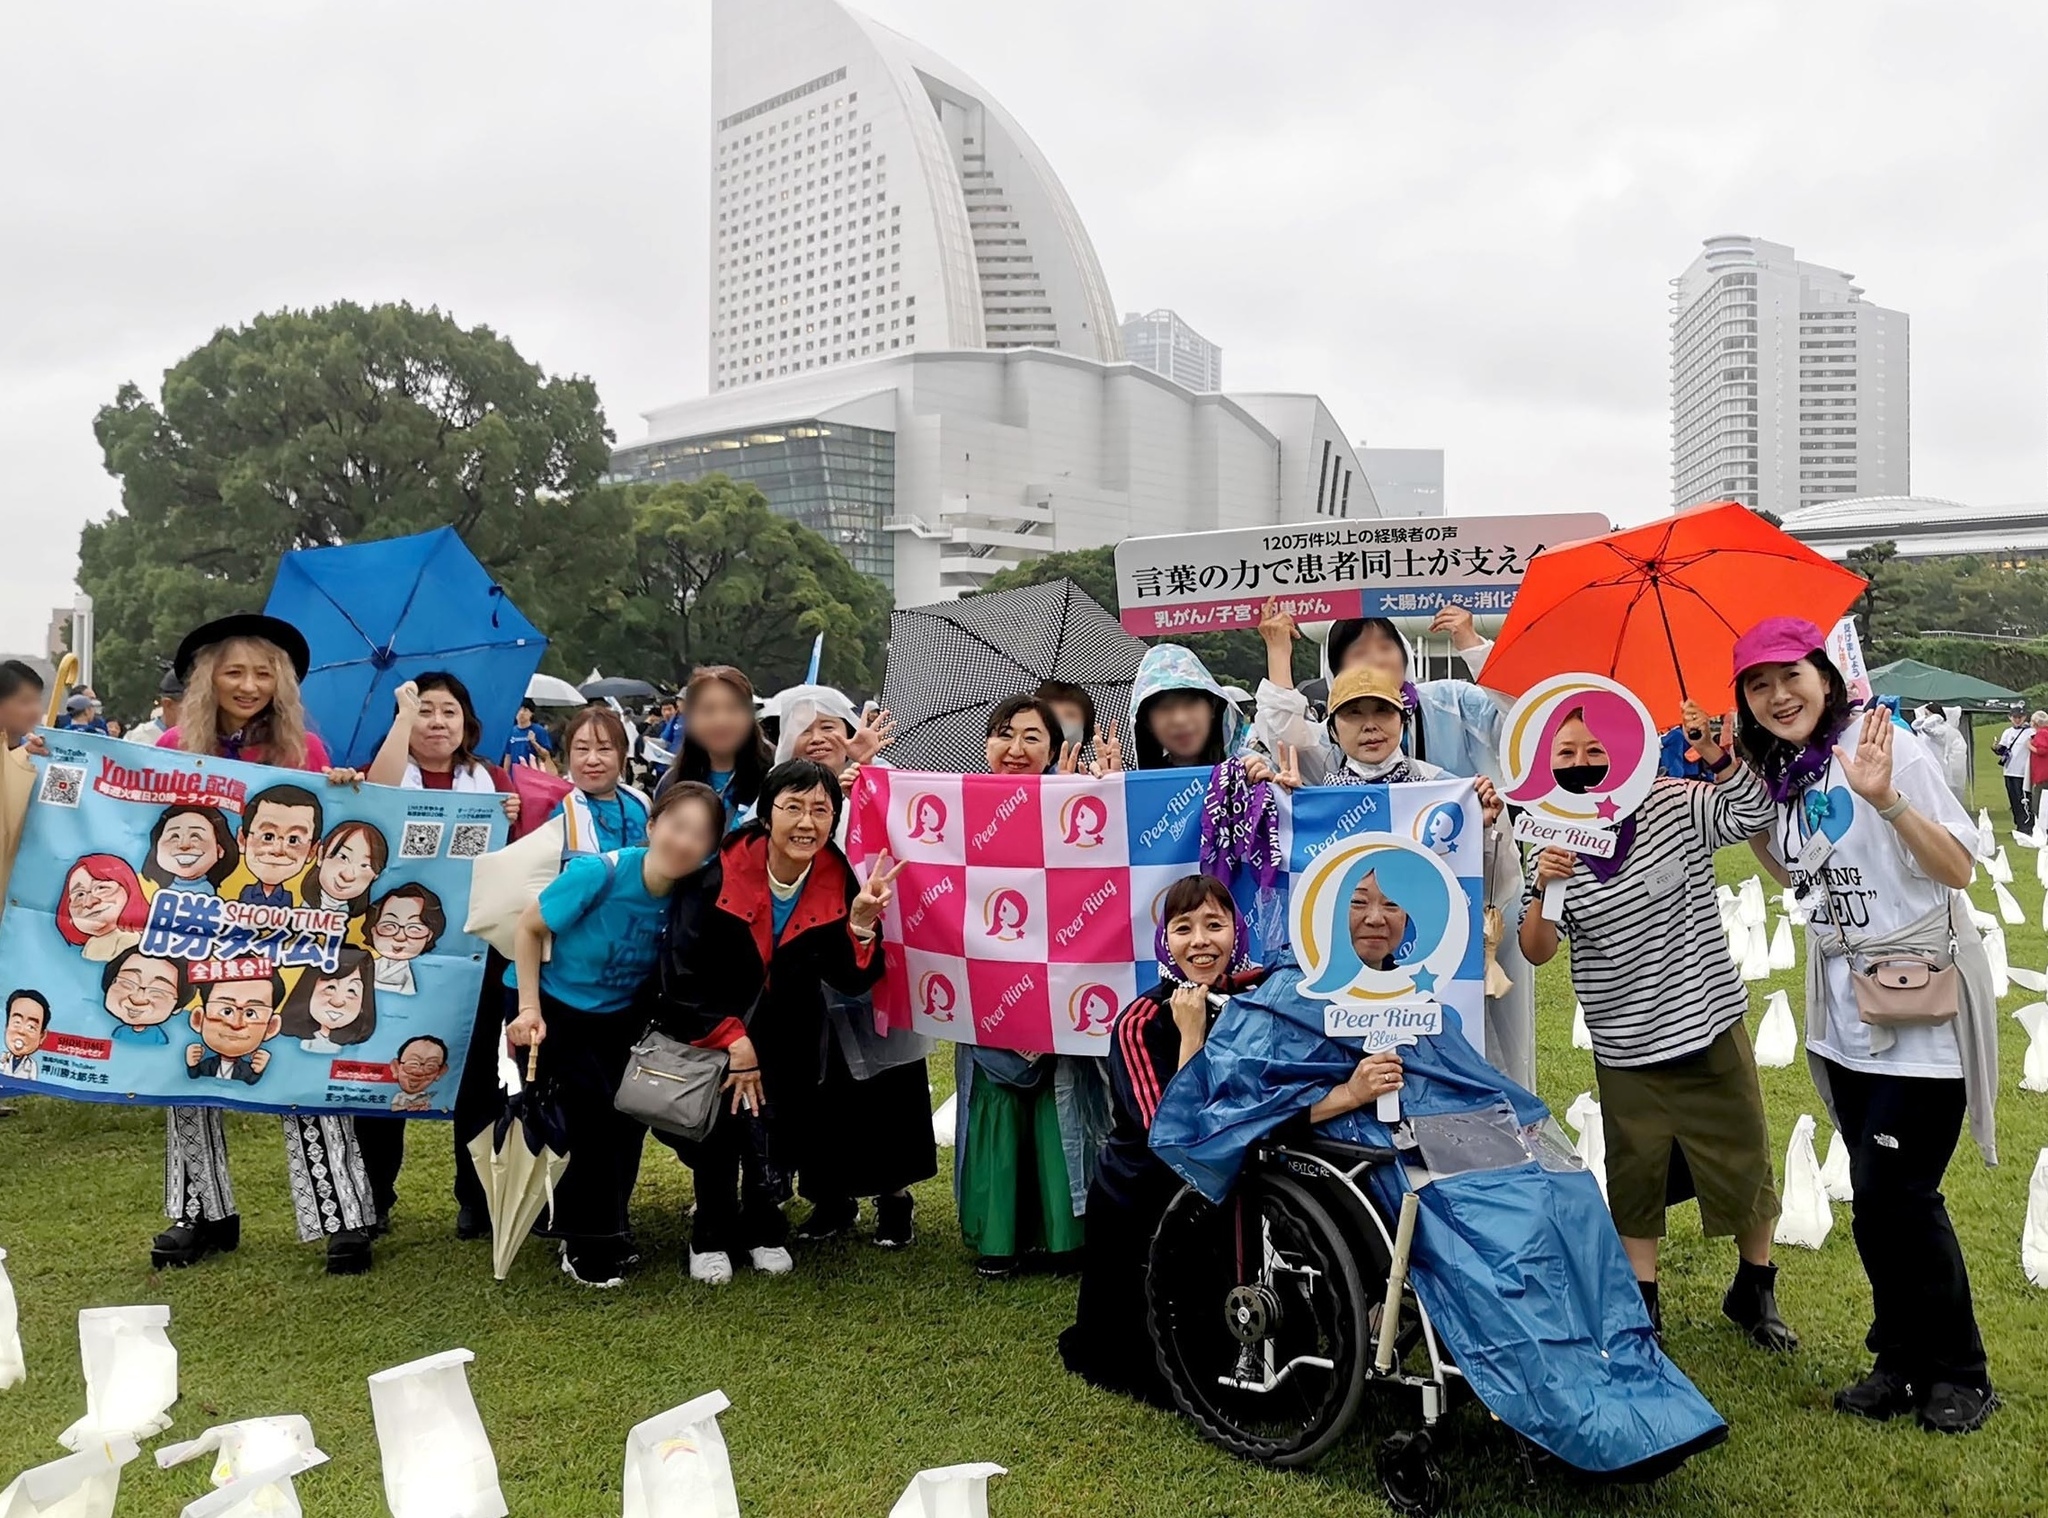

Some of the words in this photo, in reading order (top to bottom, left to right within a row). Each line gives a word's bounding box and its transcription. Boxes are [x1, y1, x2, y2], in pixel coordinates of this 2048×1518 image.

[1263, 526, 1458, 551] 120万件以上の経験者の声
[102, 755, 202, 791] YouTube
[205, 775, 247, 799] 配信
[971, 819, 999, 851] Peer
[996, 786, 1029, 822] Ring
[1139, 813, 1169, 849] Peer
[1167, 777, 1204, 816] Ring
[1303, 829, 1339, 858] Peer
[1337, 793, 1378, 834] Ring
[1268, 826, 1282, 867] JAPAN
[1519, 818, 1562, 840] Peer
[1564, 826, 1612, 855] Ring
[225, 904, 290, 928] SHOW
[294, 911, 345, 931] TIME
[904, 904, 929, 933] Peer
[919, 875, 955, 915] Ring
[1055, 913, 1085, 947] Peer
[1082, 879, 1118, 916] Ring
[191, 959, 271, 980] 全員集合!!
[980, 1003, 1005, 1033] Peer
[1001, 973, 1035, 1008] Ring
[1329, 1008, 1380, 1029] Peer
[1383, 1007, 1437, 1031] Ring
[1366, 1030, 1399, 1050] Bleu
